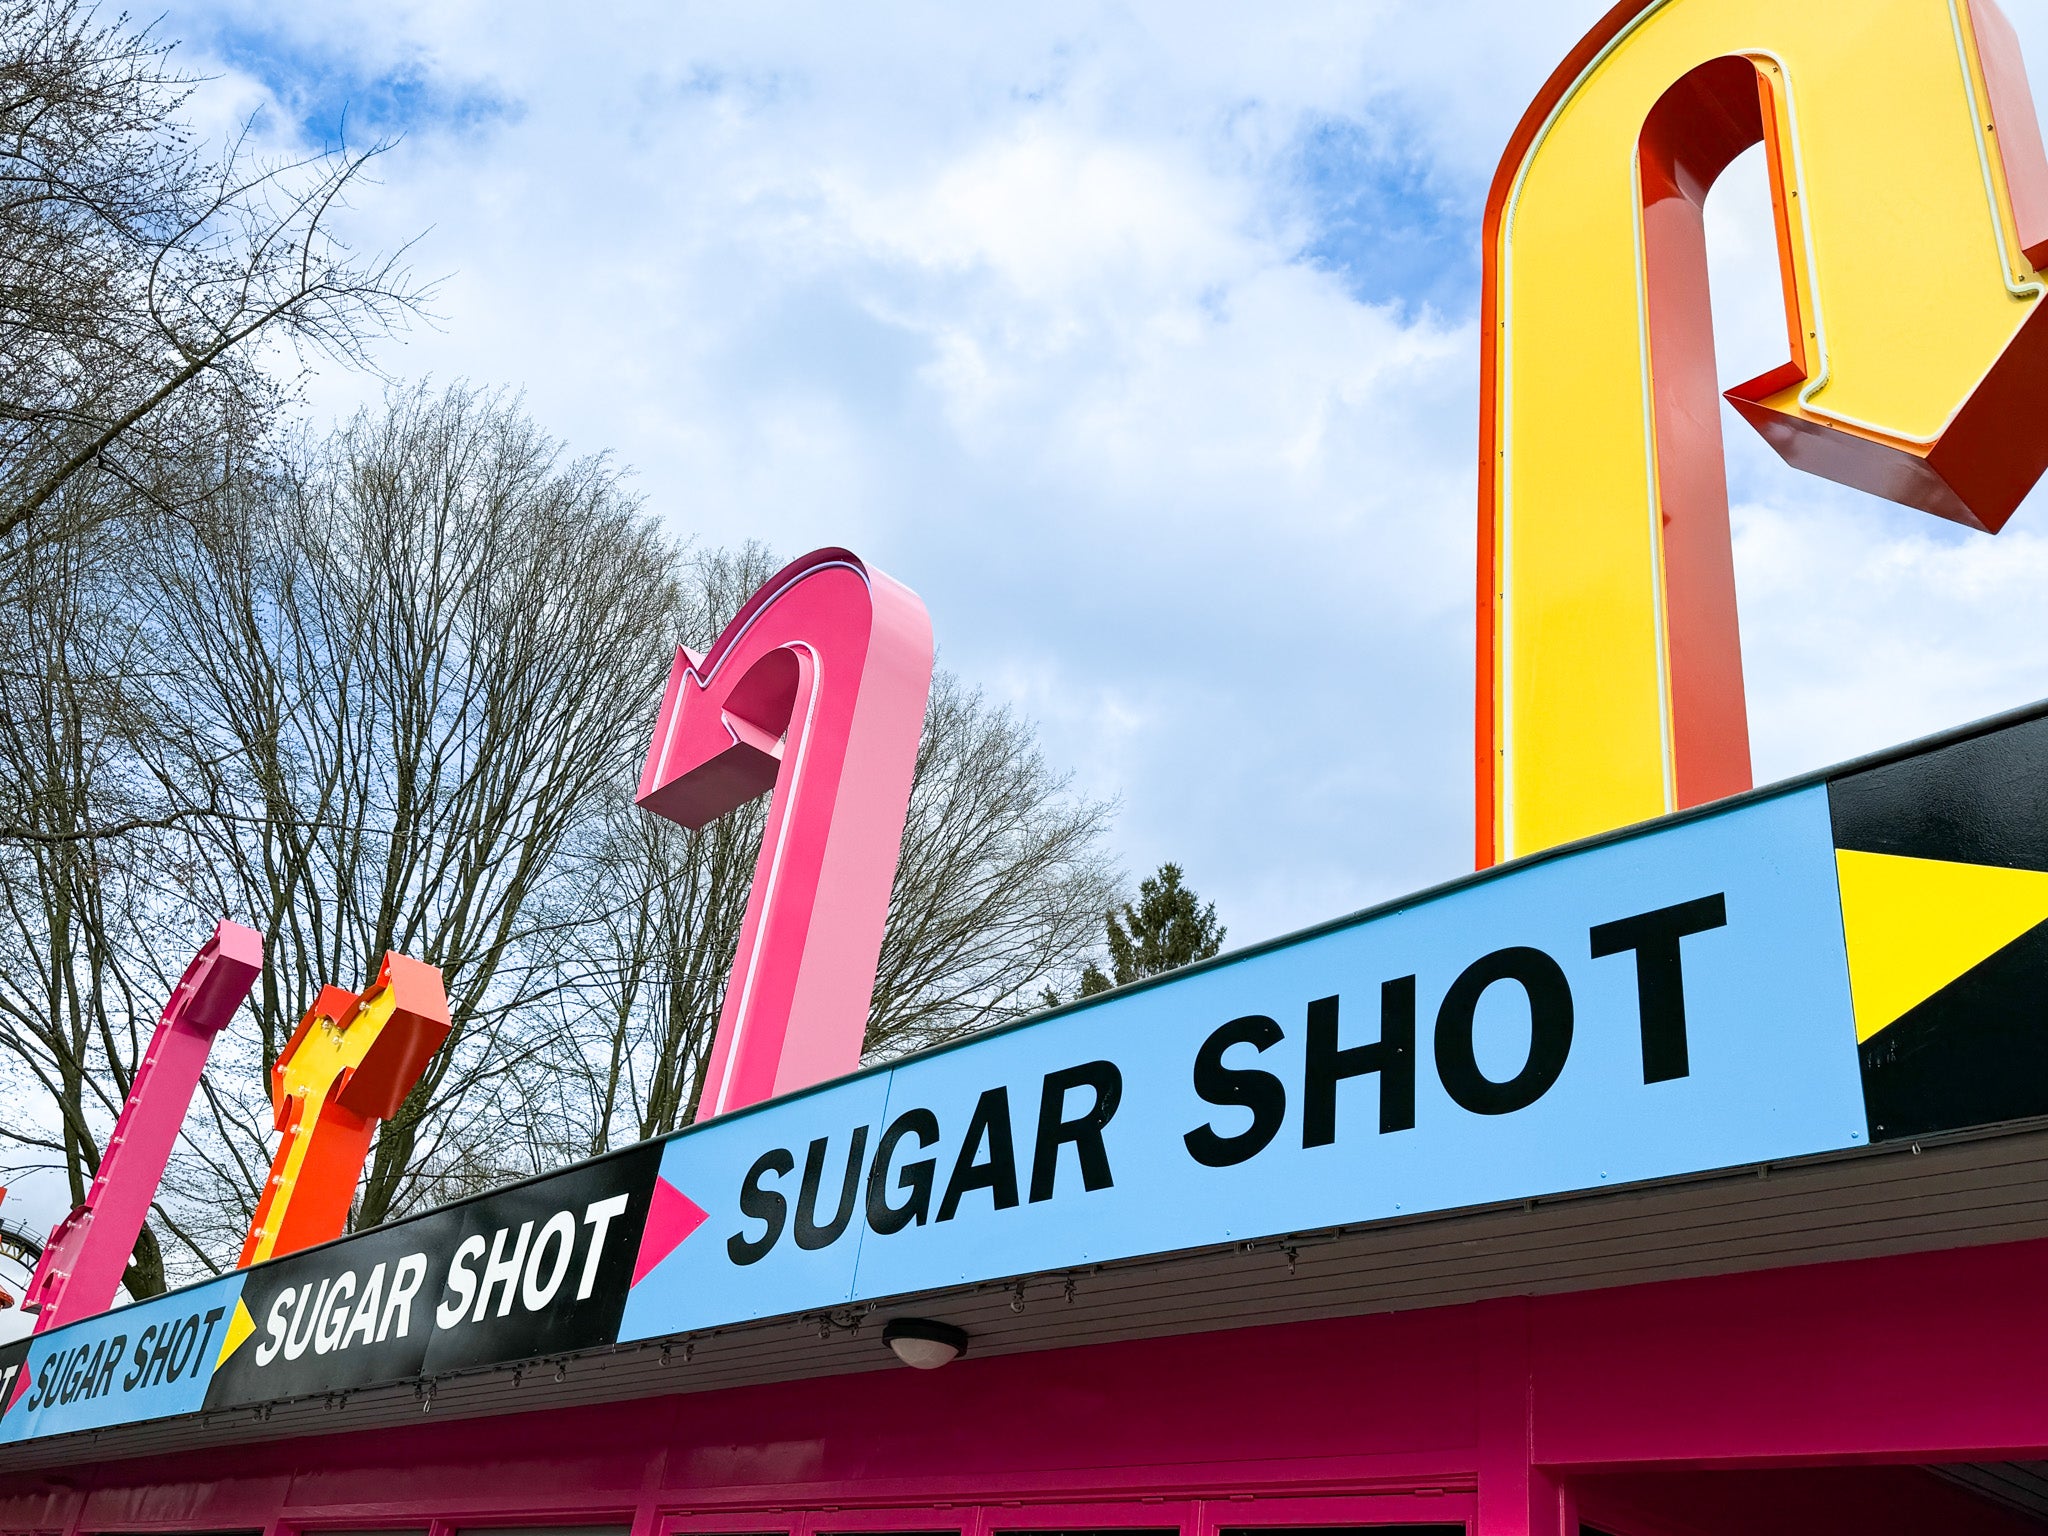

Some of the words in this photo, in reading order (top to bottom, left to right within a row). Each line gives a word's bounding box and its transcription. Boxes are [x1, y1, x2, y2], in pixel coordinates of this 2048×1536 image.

[727, 1060, 1122, 1266] SUGAR
[1184, 892, 1727, 1168] SHOT
[28, 1335, 127, 1412] SUGAR
[123, 1306, 226, 1392] SHOT
[255, 1253, 428, 1367] SUGAR
[436, 1193, 630, 1330] SHOT
